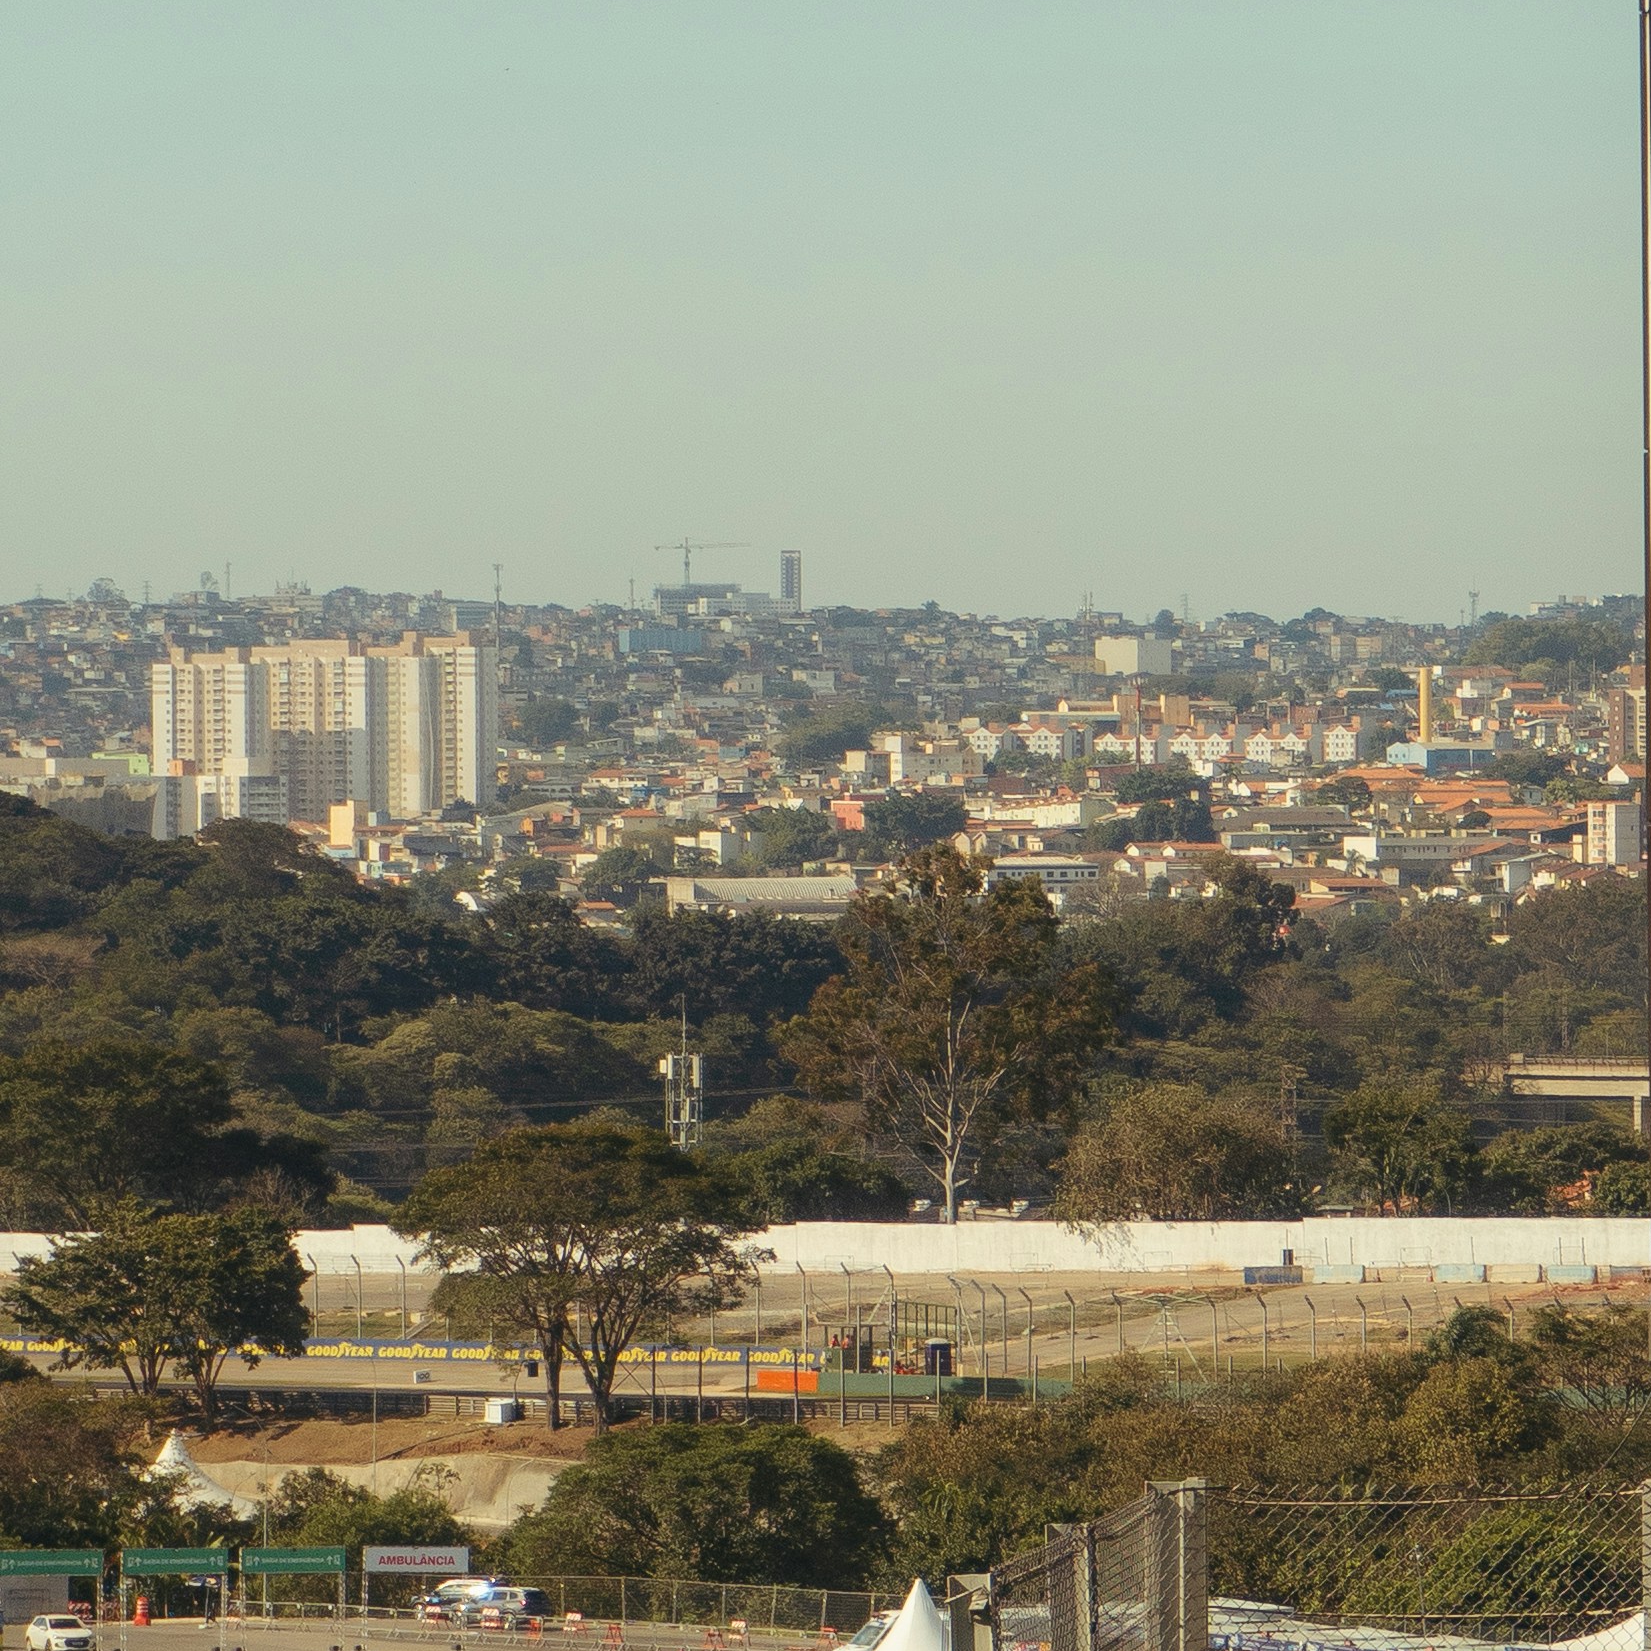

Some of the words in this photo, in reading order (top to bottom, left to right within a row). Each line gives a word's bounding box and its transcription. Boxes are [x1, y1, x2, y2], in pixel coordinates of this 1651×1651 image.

[306, 1342, 374, 1358] GOODYEAR
[378, 1343, 448, 1359] GOODYEAR
[378, 1553, 456, 1566] AMBULÂNCIA
